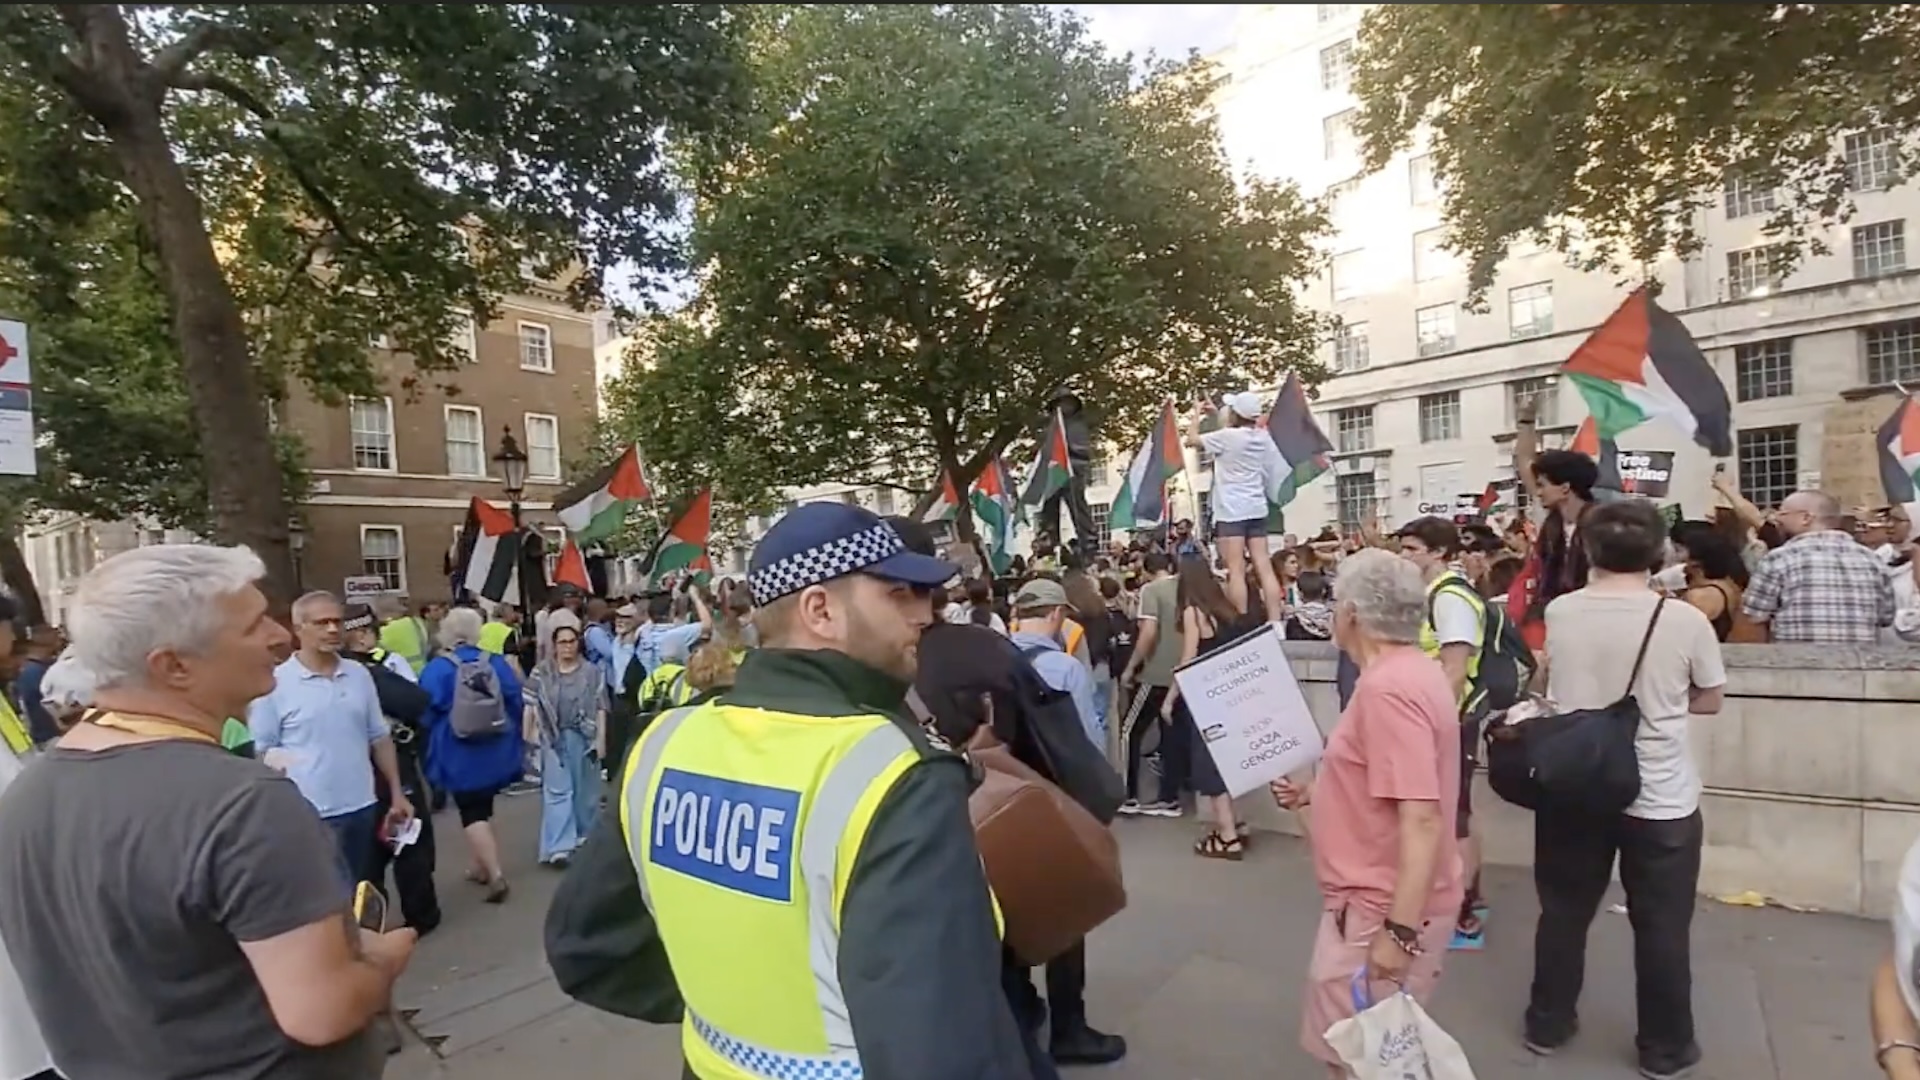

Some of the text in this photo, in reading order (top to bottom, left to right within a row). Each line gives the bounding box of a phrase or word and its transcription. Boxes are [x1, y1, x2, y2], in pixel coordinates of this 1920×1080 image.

[1206, 665, 1270, 699] OCCUPATION
[1240, 737, 1302, 770] GENOCIDE
[1249, 730, 1282, 751] GAZA
[655, 786, 786, 880] POLICE
